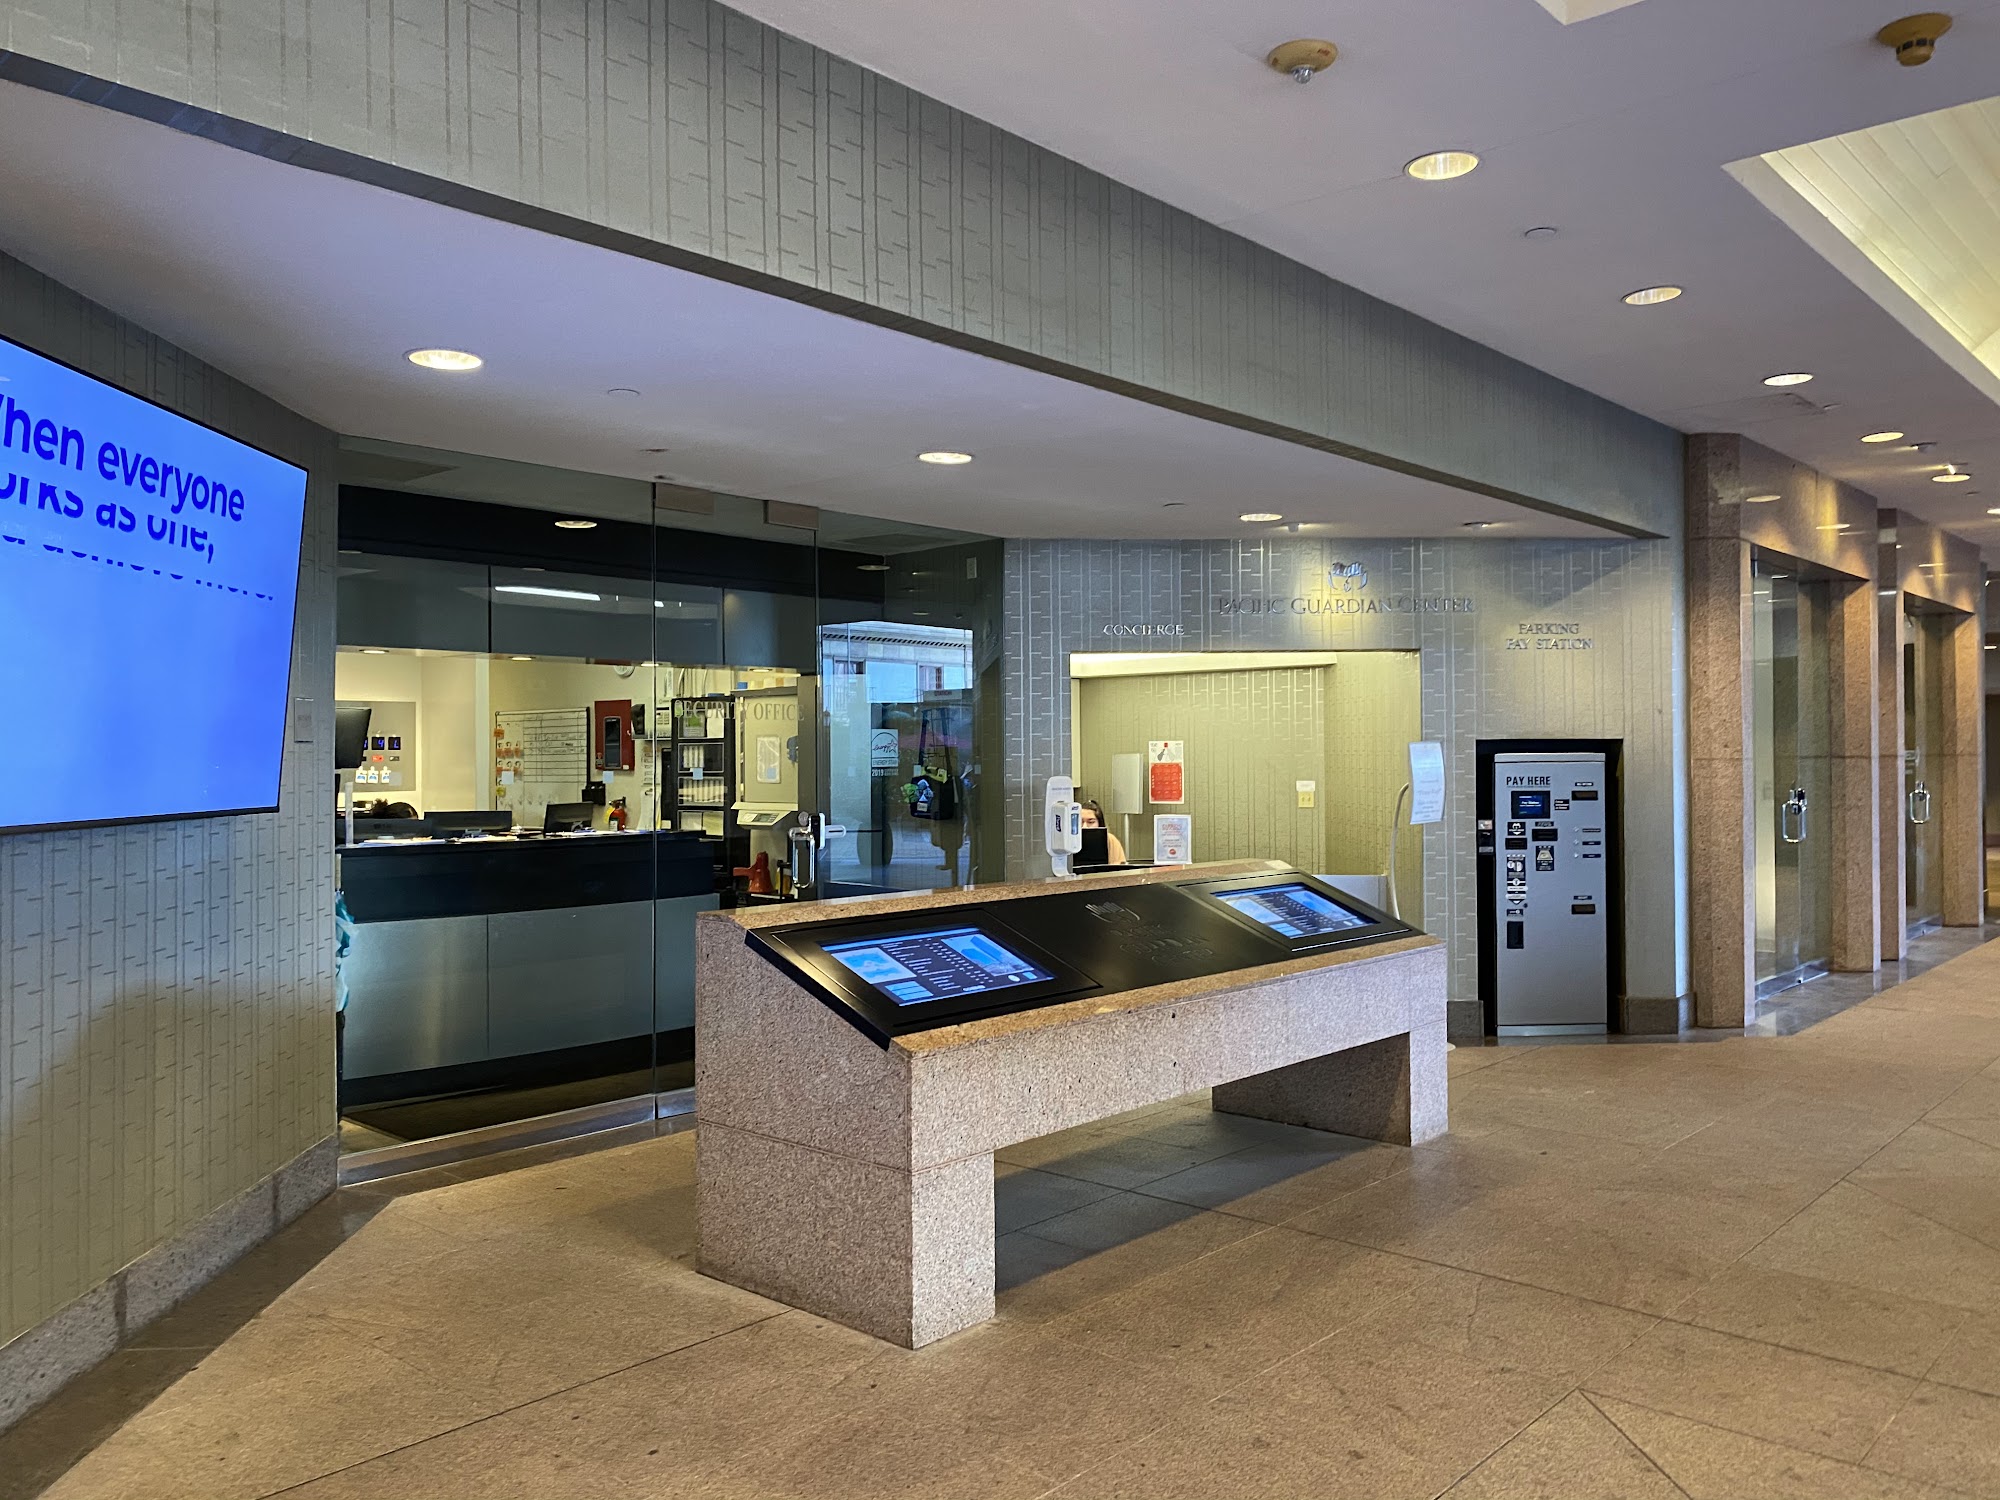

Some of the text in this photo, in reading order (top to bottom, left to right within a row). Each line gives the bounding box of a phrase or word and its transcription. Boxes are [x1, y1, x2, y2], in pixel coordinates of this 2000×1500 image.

[0, 393, 245, 522] hen everyone
[1219, 596, 1475, 614] PACIFIC GUARDIAN CENTER
[1103, 624, 1185, 636] CONCIERGE
[1518, 623, 1579, 635] PARKING
[1506, 638, 1593, 650] PAY STATION
[754, 702, 805, 721] OFFICE
[1506, 776, 1551, 786] PAY HERE
